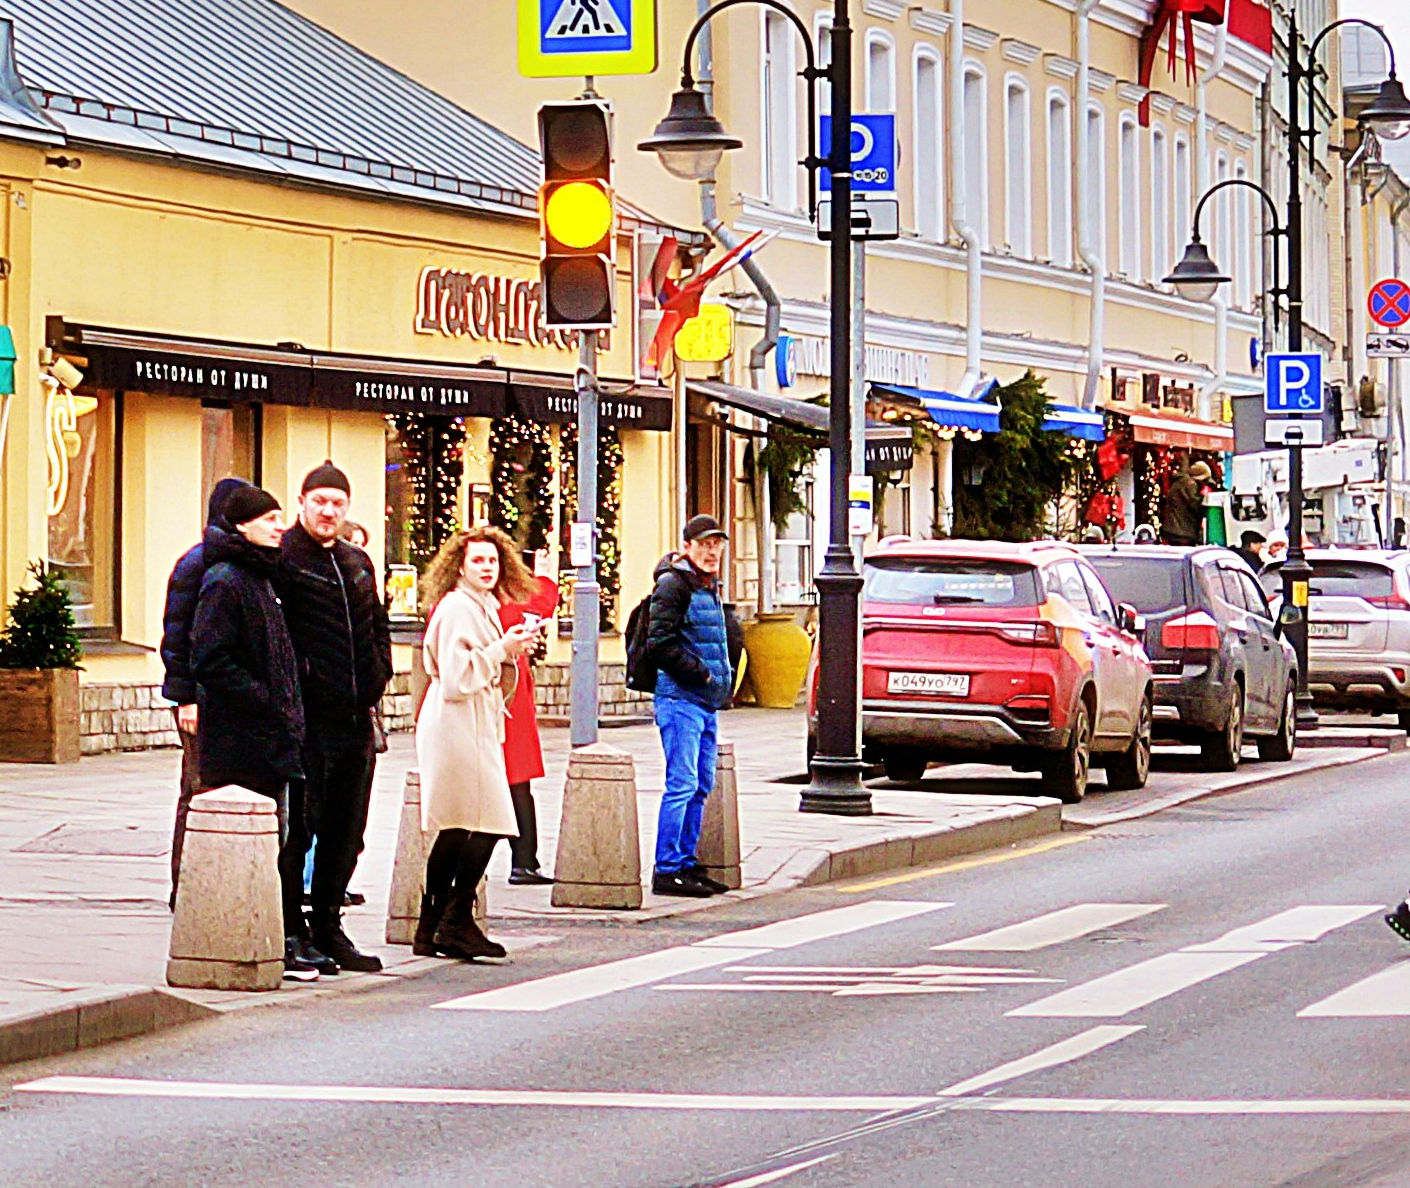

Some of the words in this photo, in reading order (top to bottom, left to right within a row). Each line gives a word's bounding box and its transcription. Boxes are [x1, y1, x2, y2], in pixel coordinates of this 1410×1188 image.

[874, 170, 888, 181] 20
[415, 265, 611, 356] ДЖОНД
[136, 361, 203, 384] РЕСТОРАН
[211, 369, 226, 386] ОТ
[234, 371, 268, 390] ДУШИ
[1279, 360, 1311, 406] P
[355, 381, 414, 401] РЕСТОРАН
[421, 386, 433, 402] ОТ
[440, 387, 469, 405] ДУШИ
[547, 396, 578, 414] РЕСТО
[601, 401, 612, 416] ОТ
